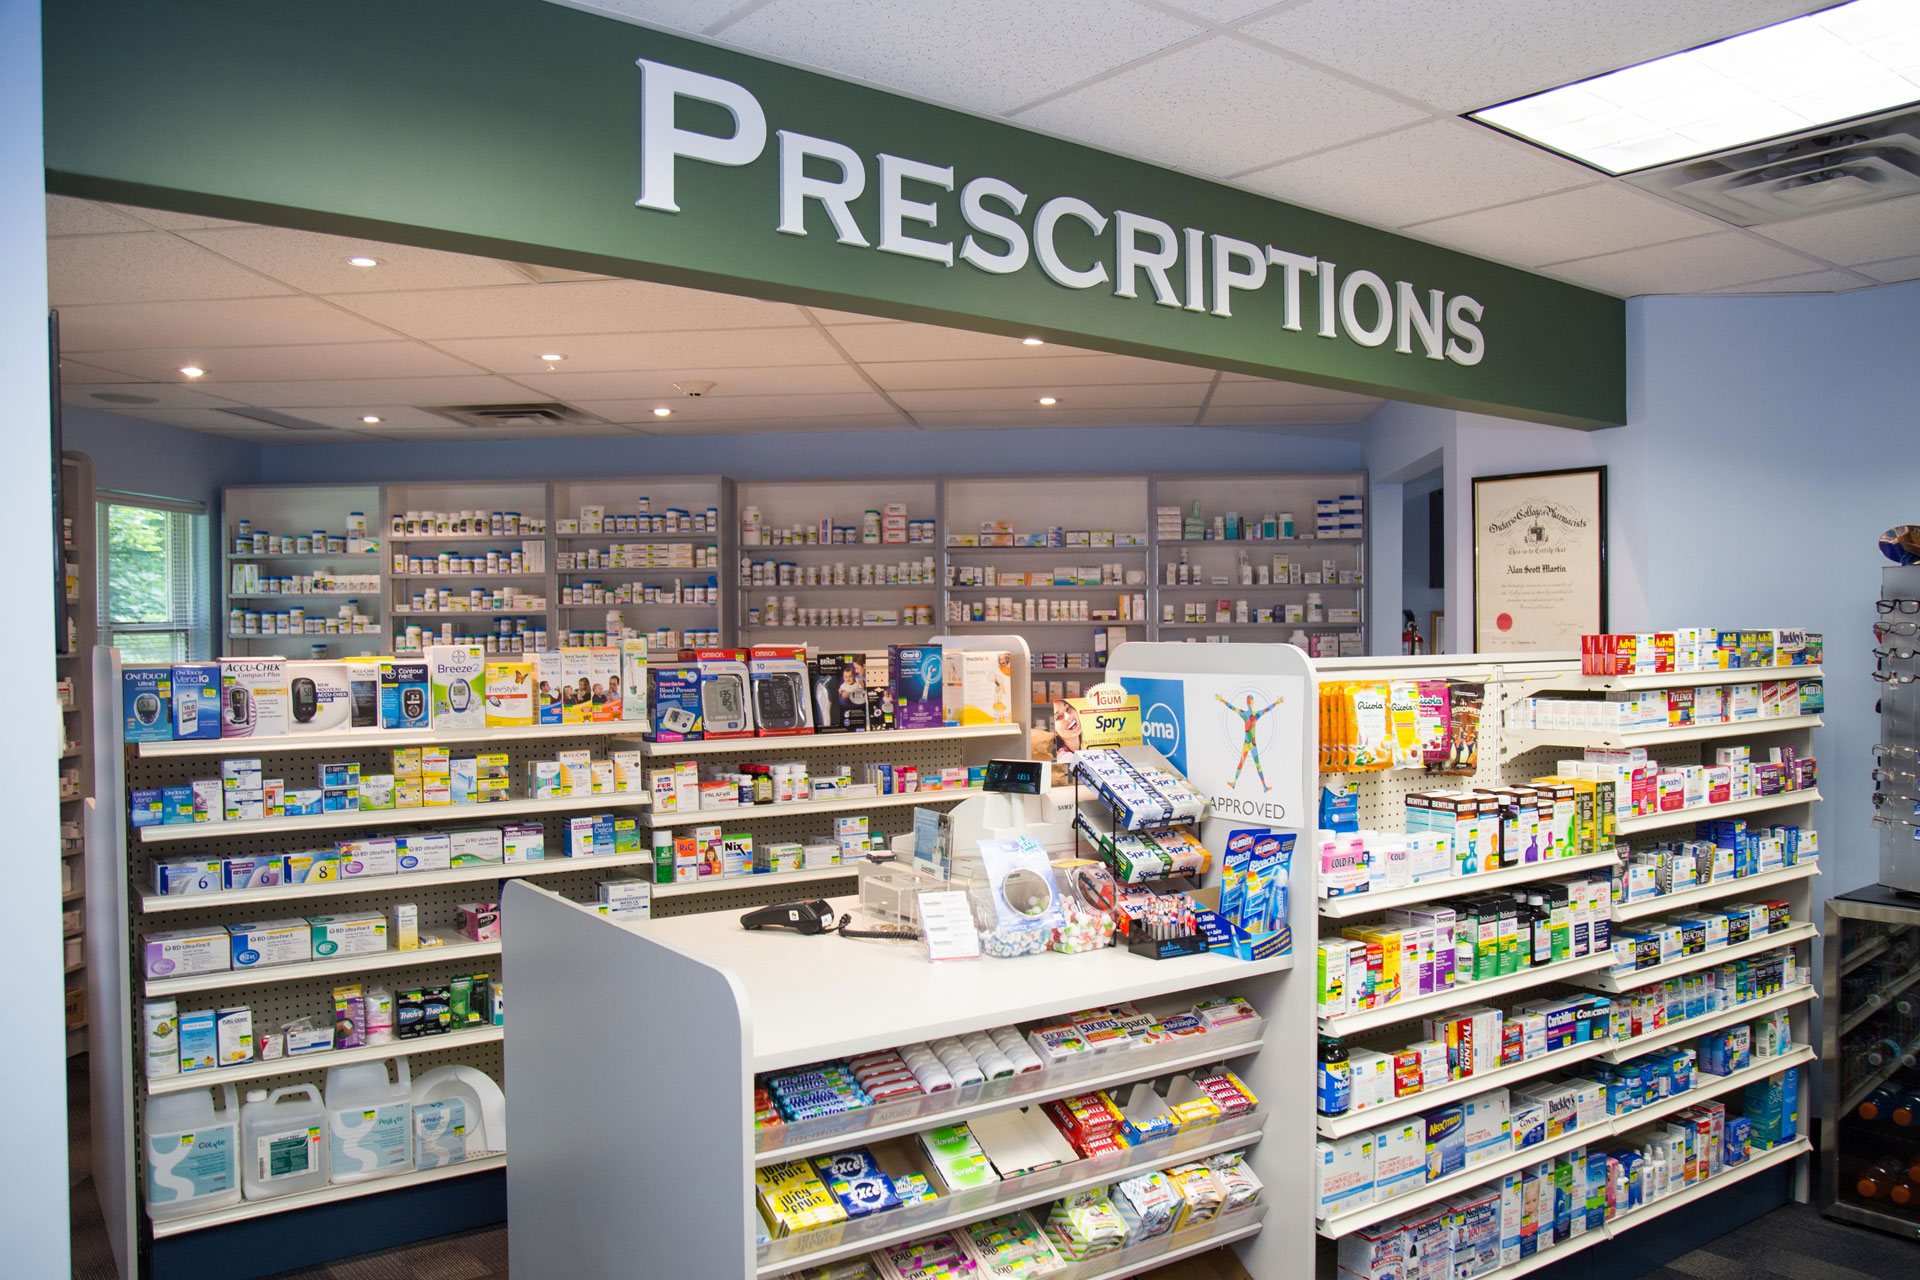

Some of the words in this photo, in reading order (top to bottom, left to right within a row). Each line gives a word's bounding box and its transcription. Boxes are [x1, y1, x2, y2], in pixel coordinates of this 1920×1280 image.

[1506, 565, 1523, 574] Alan
[1542, 564, 1566, 573] Martin
[1741, 634, 1756, 642] Advil
[1758, 633, 1772, 641] Advil
[1780, 631, 1804, 644] Buckley's
[1618, 639, 1636, 648] Advil
[1656, 638, 1674, 647] Advil
[226, 663, 281, 672] ACCU-CHEK
[1100, 696, 1122, 704] GUM
[1419, 695, 1443, 706] icola
[1358, 701, 1384, 711] Ricola
[1391, 703, 1414, 712] Ricola
[1096, 715, 1126, 732] Spry
[1083, 752, 1107, 761] Spry
[1098, 767, 1122, 776] Spry
[1112, 782, 1137, 792] Spry
[1152, 778, 1176, 787] Spry
[1661, 778, 1681, 786] Benadryl
[1168, 792, 1192, 801] Spry
[1128, 798, 1152, 806] Spry
[1406, 797, 1429, 807] BENYLIN
[1431, 800, 1455, 810] BENYLIN
[1479, 802, 1499, 811] BENYLIN
[1210, 796, 1285, 820] APPROVED
[1457, 803, 1477, 812] BENYLIN
[725, 842, 747, 856] Nix
[1167, 845, 1191, 855] Spry
[1126, 850, 1152, 859] Spry
[1249, 856, 1275, 871] Bleach
[1276, 851, 1289, 862] Pen
[1332, 857, 1355, 868] COLD-FX
[260, 869, 270, 884] 6
[319, 865, 328, 879] 8
[198, 876, 208, 889] 6
[1770, 907, 1790, 919] REACTINE
[1730, 918, 1749, 930] REACTINE
[1683, 929, 1705, 940] REACTINE
[1636, 942, 1660, 952] REACTINE
[1080, 1018, 1118, 1033] SUCRETS
[1043, 1028, 1075, 1041] SUCRETS
[1462, 1021, 1472, 1071] TYLENOL
[776, 1072, 823, 1088] mentos
[1203, 1076, 1224, 1085] HALLS
[782, 1078, 828, 1094] mentos
[1210, 1082, 1231, 1092] HALLS
[1217, 1089, 1238, 1099] HALLS
[1226, 1097, 1246, 1107] HALLS
[1089, 1115, 1111, 1125] HALLS
[1090, 1137, 1112, 1148] HALLS
[850, 1182, 883, 1200] excel
[779, 1187, 812, 1212] juicy
[790, 1195, 825, 1214] fruit
[1466, 1204, 1491, 1217] NeilMed
[1417, 1220, 1441, 1233] NeilMed
[1468, 1227, 1480, 1239] 100
